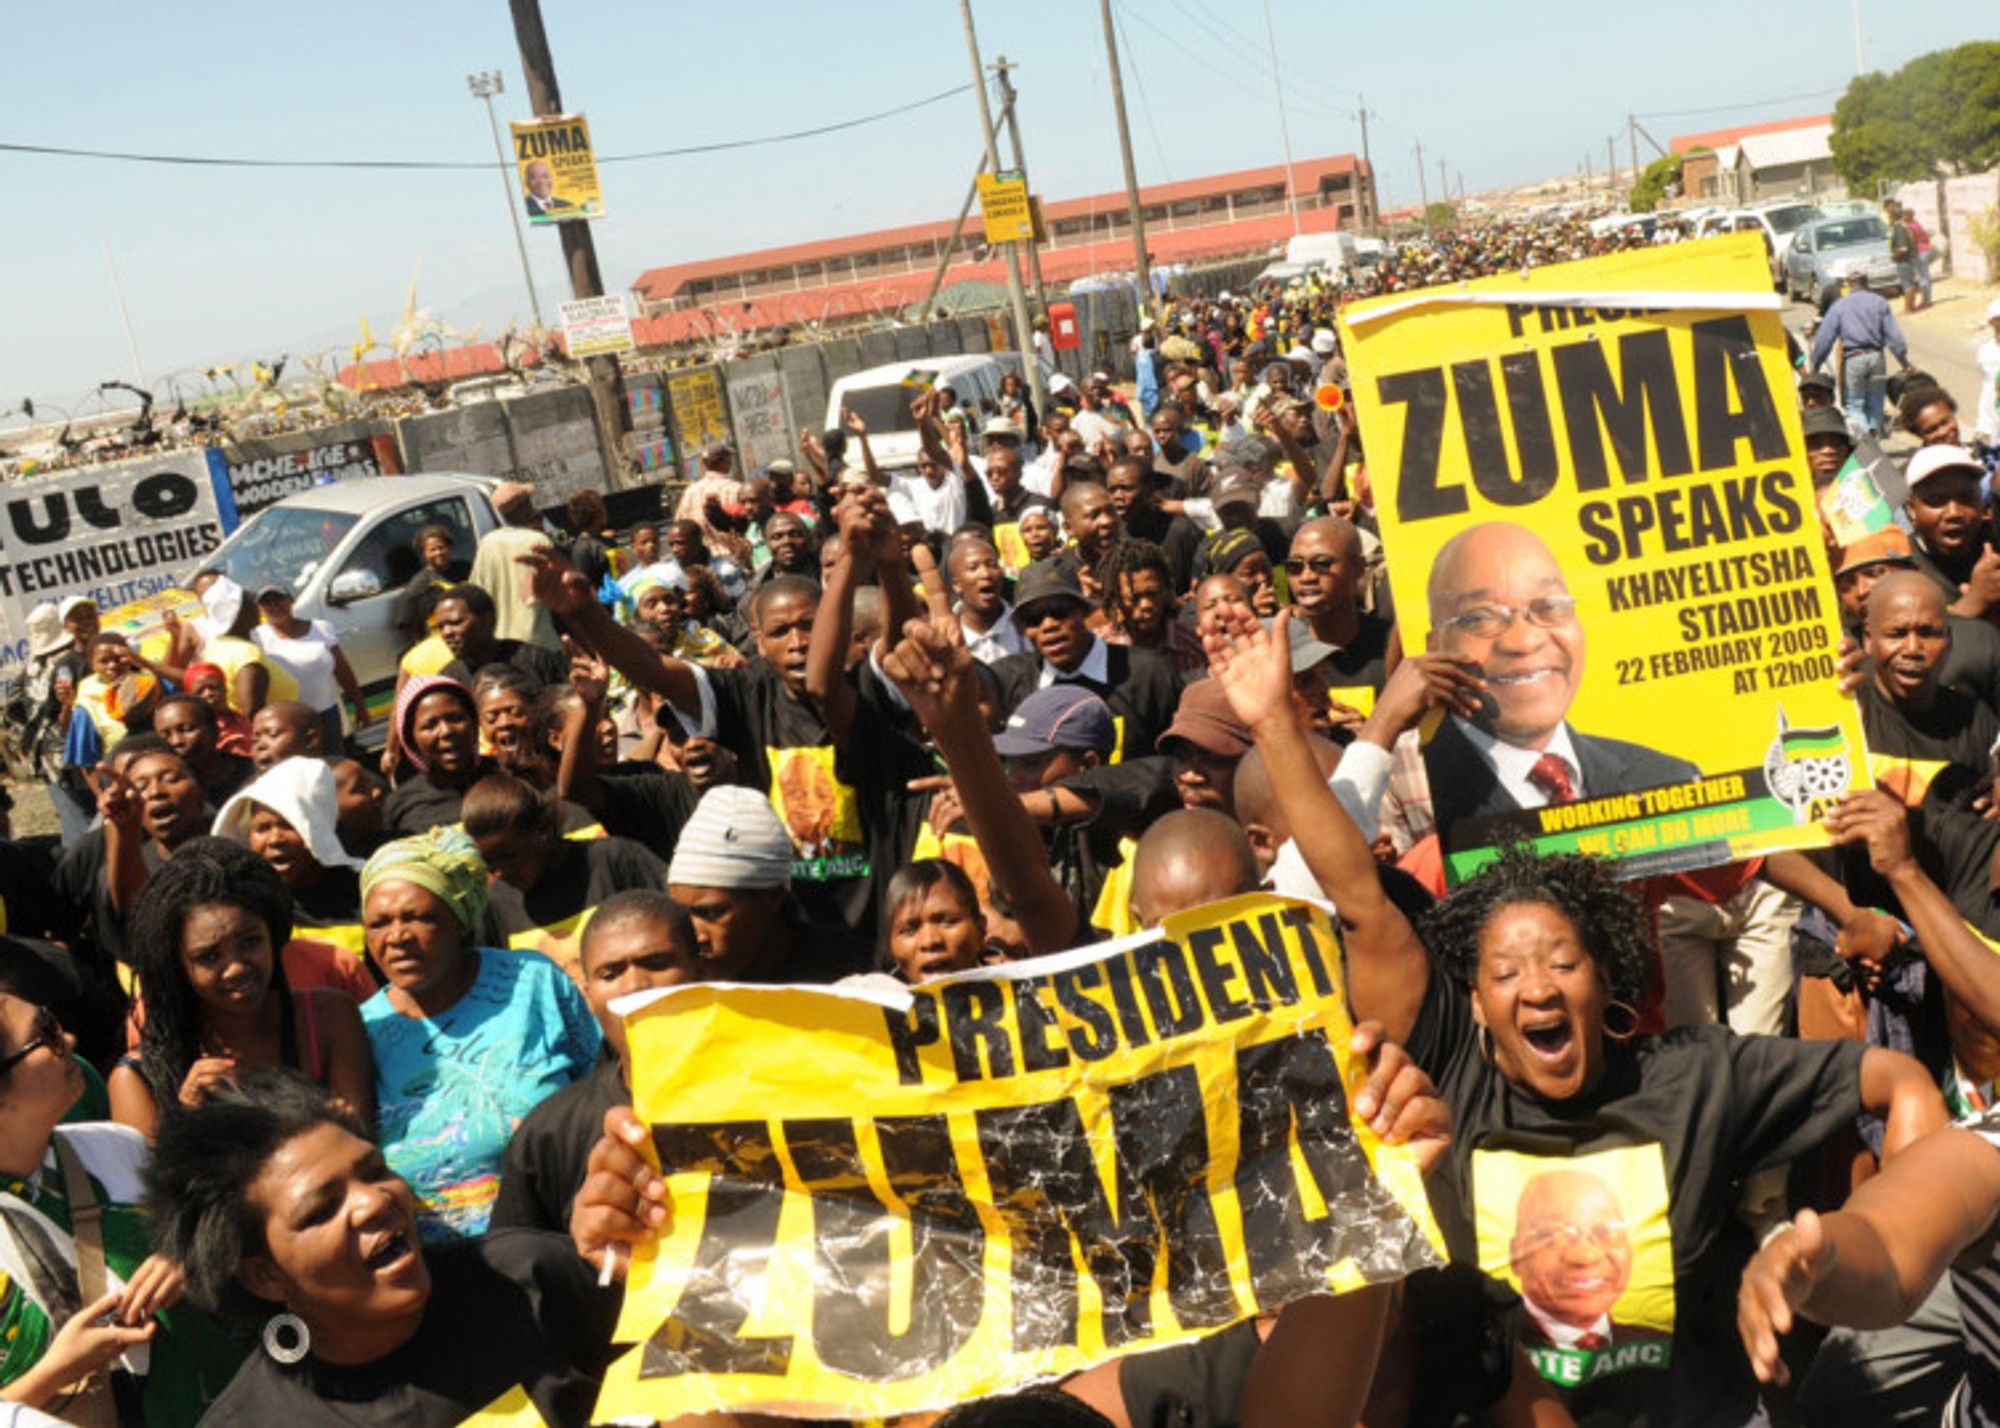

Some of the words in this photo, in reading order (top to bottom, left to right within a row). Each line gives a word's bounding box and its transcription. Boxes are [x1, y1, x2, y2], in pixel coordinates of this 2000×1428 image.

[516, 126, 589, 160] ZUMA
[1377, 315, 1790, 523] ZUMA
[0, 473, 198, 548] ULO
[1578, 470, 1802, 565] SPEAKS
[0, 523, 221, 597] TECHNOLOGIES
[1606, 546, 1815, 612] KHAYELITSHA
[1678, 586, 1822, 643] STADIUM
[1615, 656, 1646, 685] 22
[1650, 636, 1763, 680] FEBRUARY
[1768, 624, 1829, 658] 2009
[1733, 667, 1758, 695] AT
[1766, 654, 1834, 689] 12h00
[1538, 793, 1641, 833] WORKING
[1641, 775, 1746, 815] TOGETHER
[1577, 831, 1611, 856] WE
[1614, 823, 1656, 852] CAN
[1659, 819, 1690, 844] DO
[1692, 807, 1750, 837] MORE
[884, 907, 1334, 1087] PRESIDENT
[638, 1027, 1448, 1380] ZUMA
[1592, 1343, 1663, 1378] ANC
